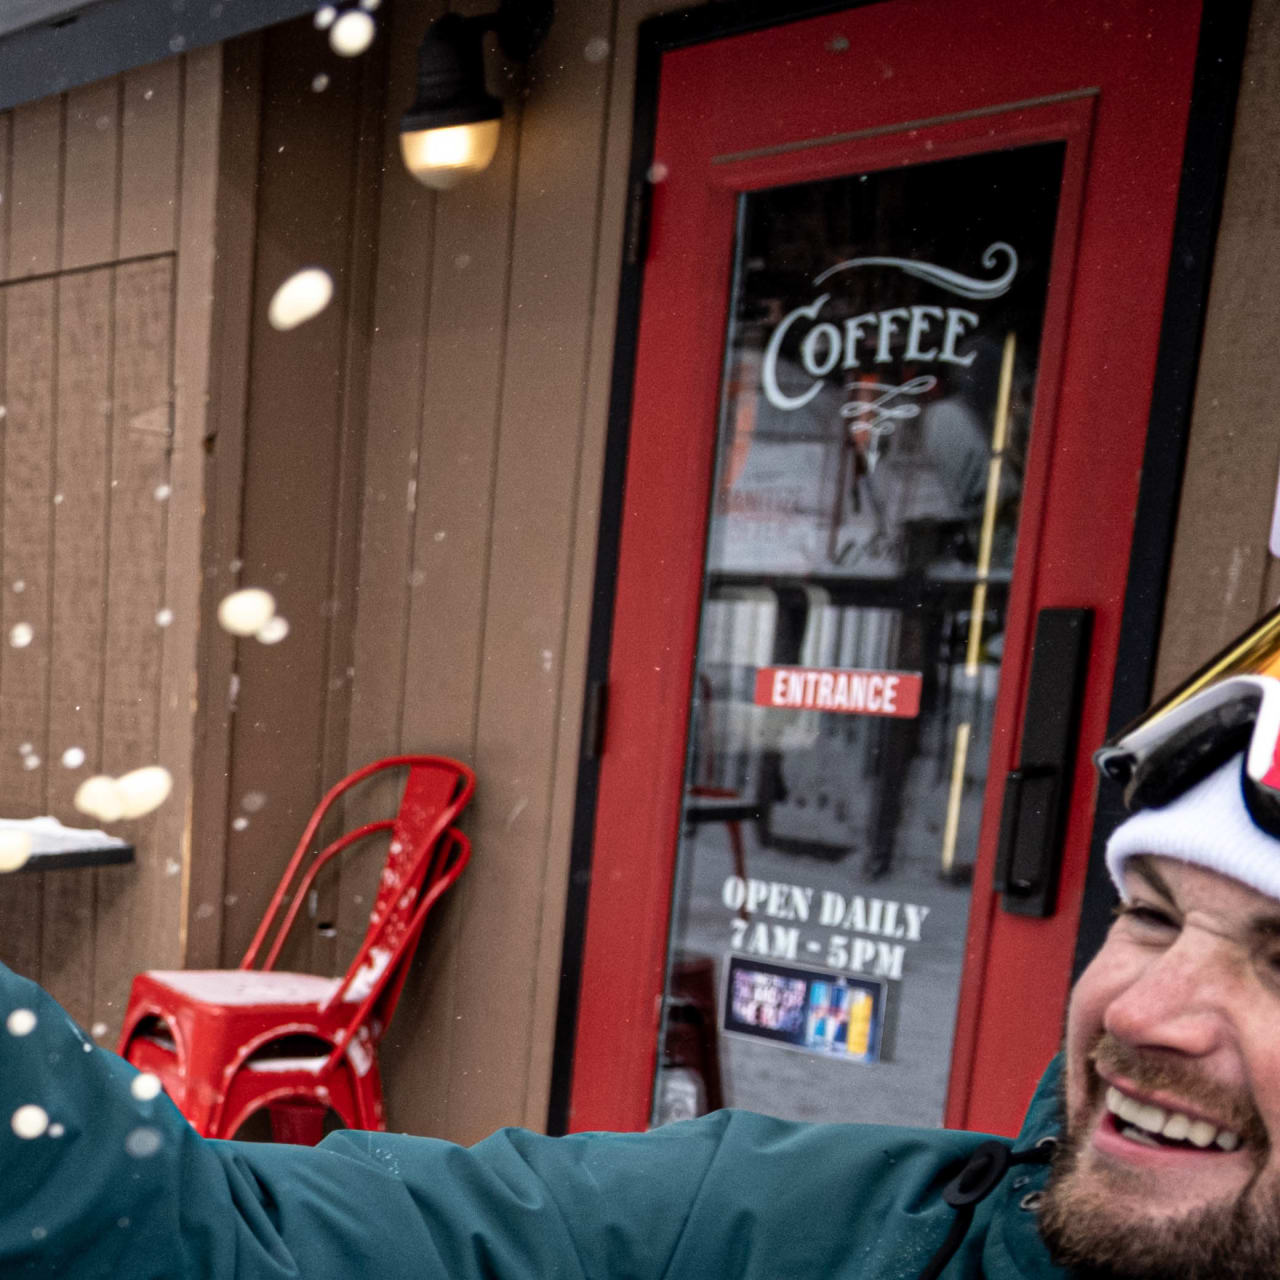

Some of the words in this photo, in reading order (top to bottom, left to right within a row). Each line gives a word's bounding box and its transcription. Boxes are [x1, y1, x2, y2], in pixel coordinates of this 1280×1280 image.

[772, 669, 900, 713] ENTRANCE
[722, 876, 814, 922] OPEN
[819, 890, 930, 942] DAILY
[730, 918, 801, 960] 7AM
[826, 933, 907, 980] 5PM
